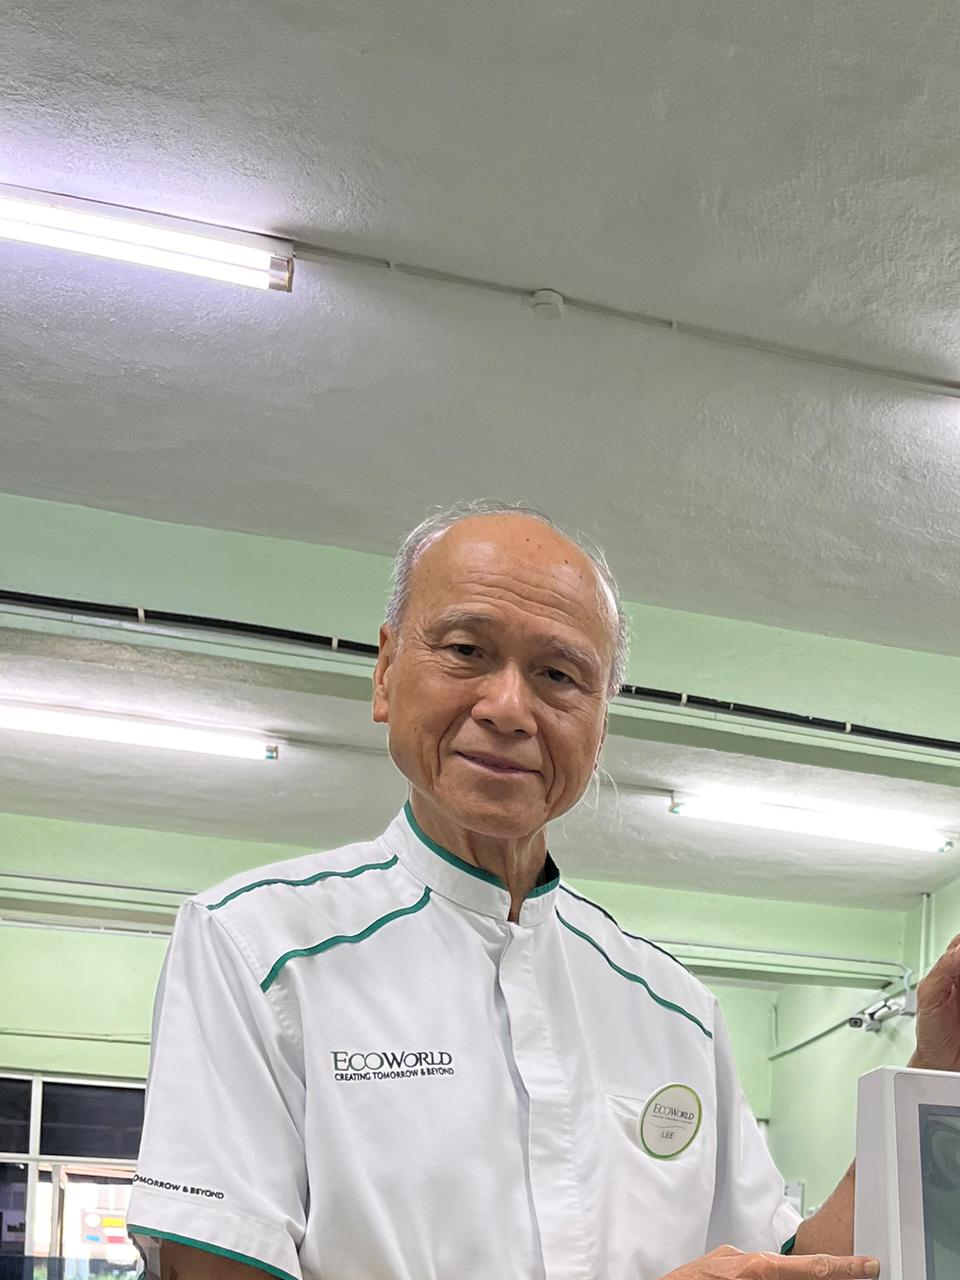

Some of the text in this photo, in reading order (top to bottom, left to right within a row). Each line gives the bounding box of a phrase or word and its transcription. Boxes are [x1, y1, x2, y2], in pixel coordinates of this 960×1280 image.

[335, 1067, 454, 1081] CREATING TOMORROW & BEYOND
[133, 1174, 180, 1191] OMORROW
[190, 1187, 225, 1199] BEYOND
